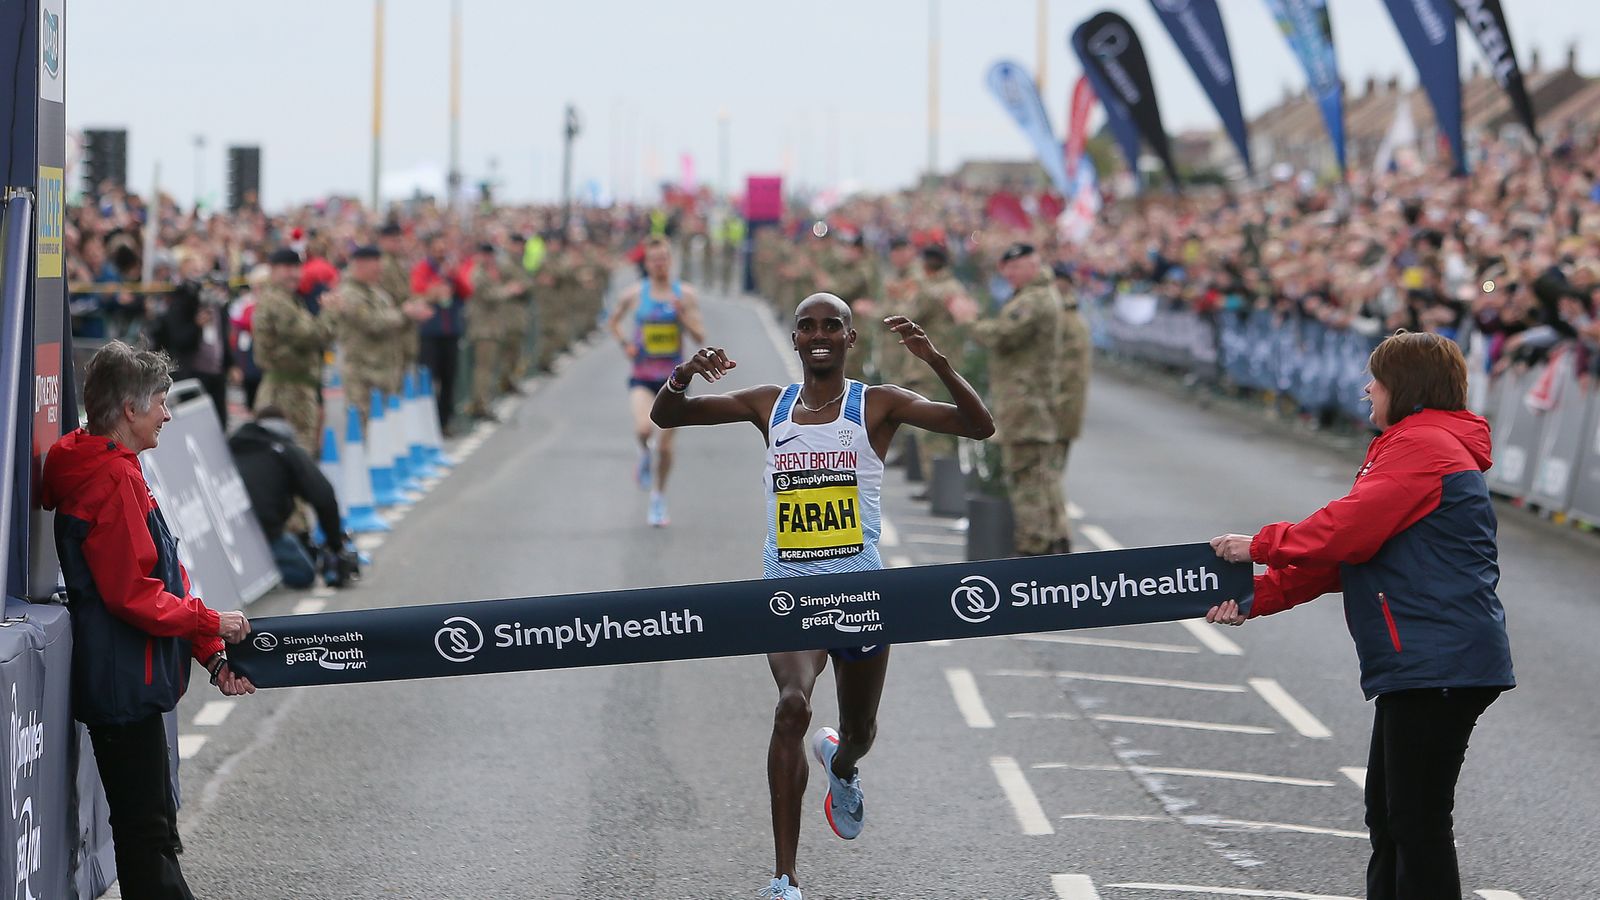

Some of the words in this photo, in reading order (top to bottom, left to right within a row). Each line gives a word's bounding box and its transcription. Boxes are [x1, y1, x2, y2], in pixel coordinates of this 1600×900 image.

[774, 452, 808, 471] GREAT
[810, 451, 858, 470] BRITAIN
[792, 473, 854, 486] Simplyhealth
[779, 498, 857, 533] FARAH
[780, 546, 860, 559] #GREATNORTHRUN
[1010, 566, 1220, 608] Simplyhealth
[799, 590, 881, 607] Simplyhealth
[801, 613, 834, 630] great
[845, 609, 880, 623] north
[861, 623, 883, 632] run
[494, 608, 704, 649] Simplyhealth
[283, 631, 364, 646] Simplyhealth
[286, 650, 318, 665] great
[329, 647, 364, 660] north
[345, 660, 367, 670] run
